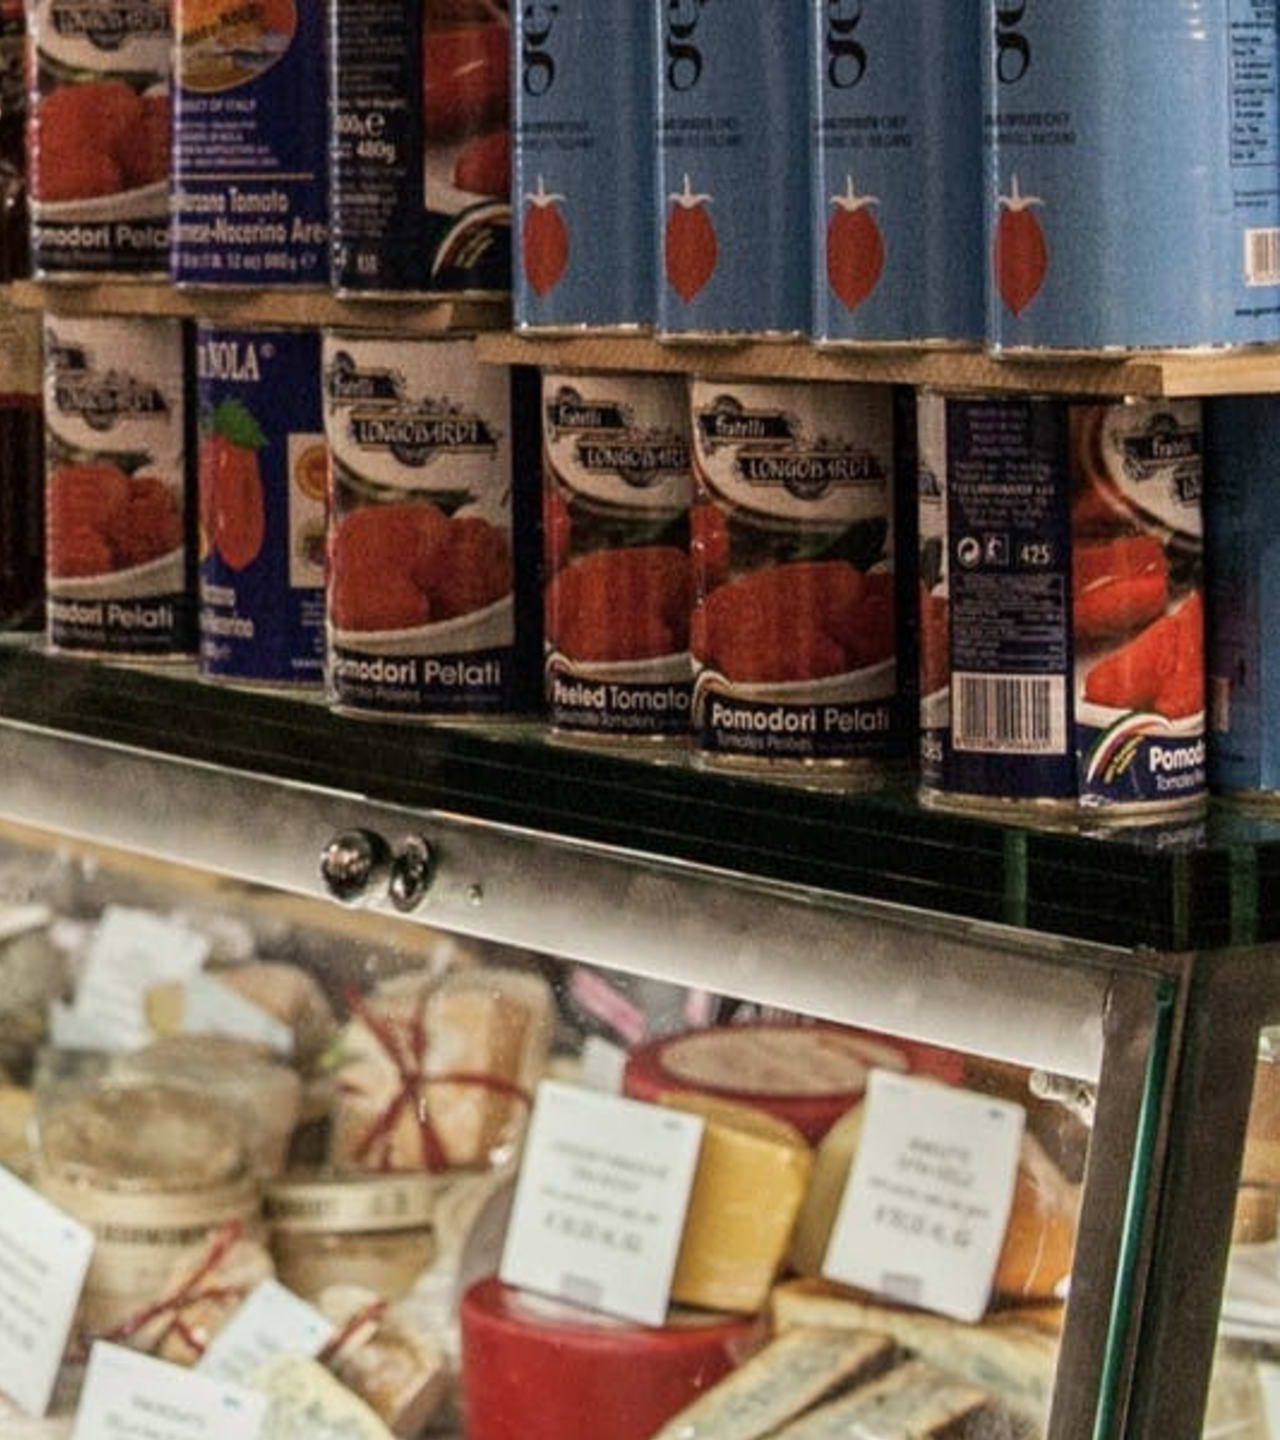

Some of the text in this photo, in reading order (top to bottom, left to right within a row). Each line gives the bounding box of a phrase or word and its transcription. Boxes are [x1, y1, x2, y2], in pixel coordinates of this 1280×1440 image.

[106, 604, 173, 629] Pelati
[424, 660, 502, 686] Pelati
[553, 680, 606, 709] Peeled
[712, 703, 890, 732] Pomodori Pelati
